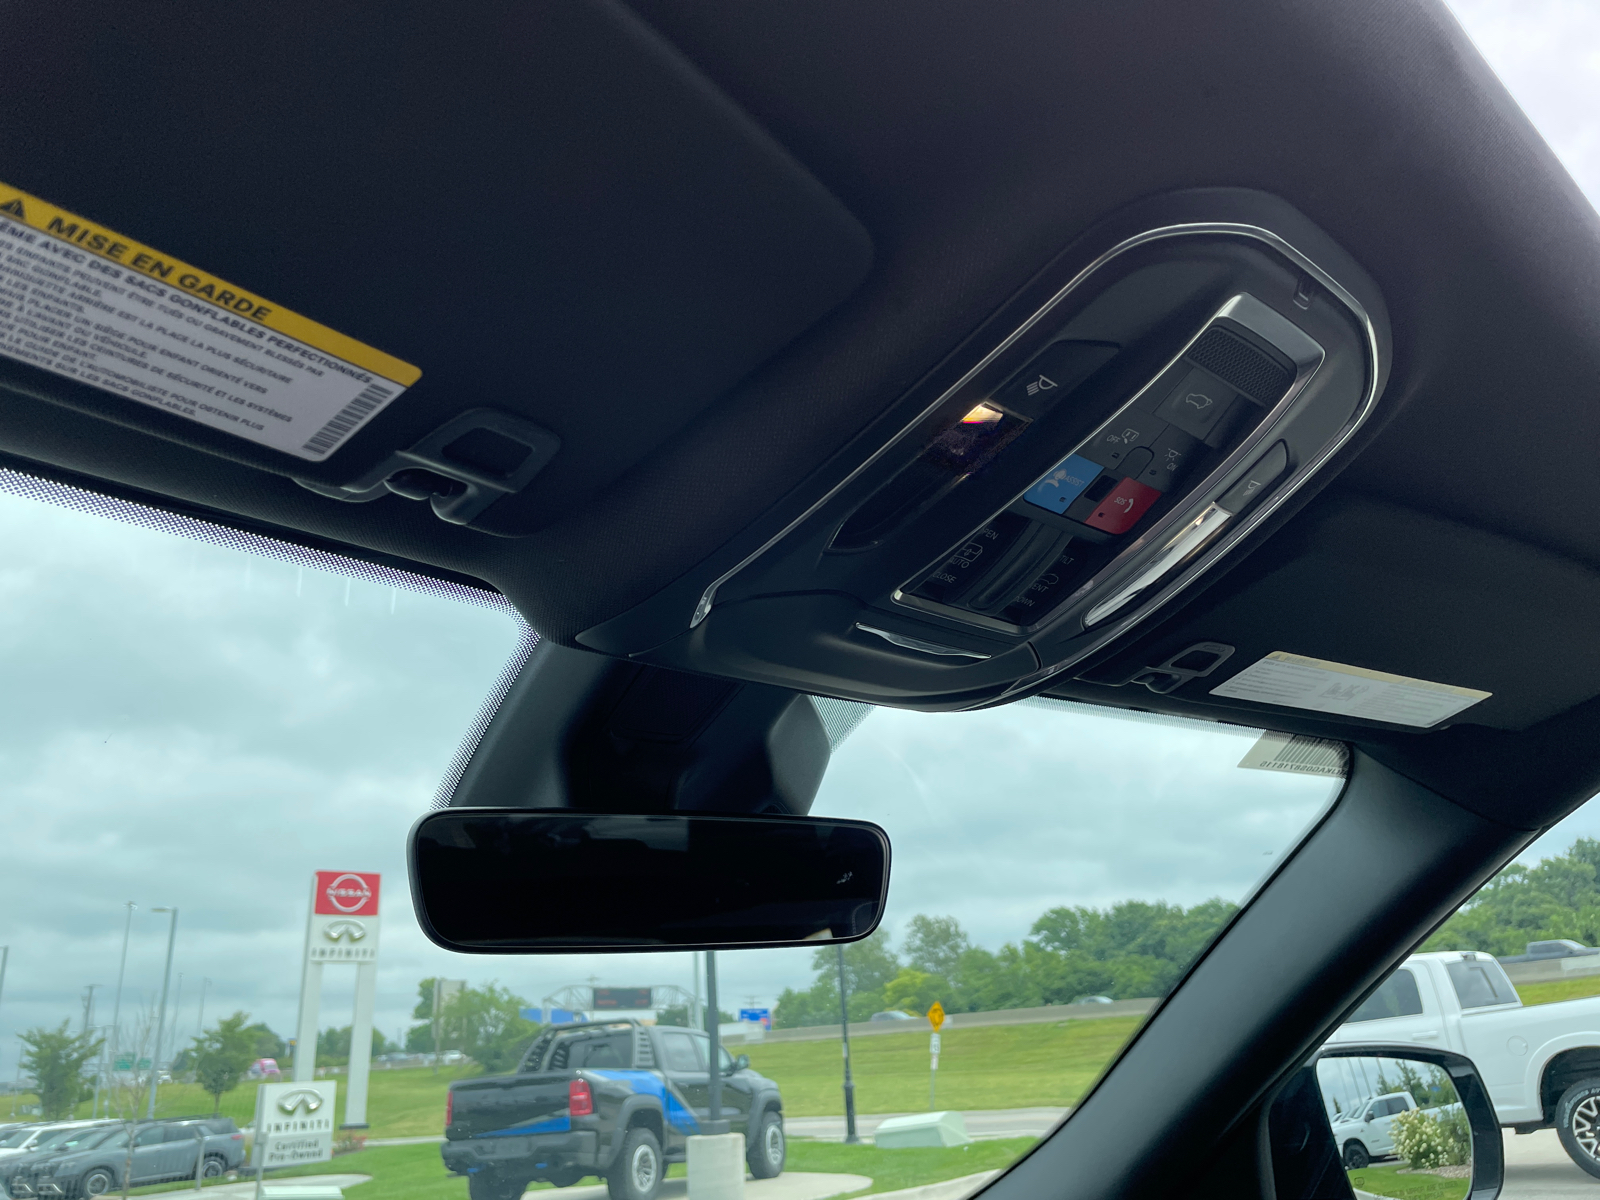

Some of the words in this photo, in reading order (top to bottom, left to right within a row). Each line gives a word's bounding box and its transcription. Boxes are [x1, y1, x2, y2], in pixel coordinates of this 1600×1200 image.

[47, 216, 127, 258] MISE
[130, 252, 173, 278] EN
[176, 272, 272, 320] GARDE
[37, 238, 86, 263] AVEC
[87, 259, 121, 278] DES
[124, 275, 167, 297] SACS
[168, 294, 265, 338] GONFLABLES
[266, 335, 374, 383] PERFECTIONNÉS
[138, 319, 154, 328] LA
[155, 326, 189, 342] PLACE
[189, 339, 204, 348] LA
[205, 345, 232, 359] PLUS
[232, 356, 292, 382] SÉCURITAIRE
[184, 316, 202, 326] OU
[202, 323, 263, 351] GRAVEMENT
[263, 348, 305, 368] BLESSÉS
[305, 365, 325, 376] PAR
[126, 336, 157, 351] POUR
[159, 348, 199, 366] ENFANT
[200, 364, 242, 383] ORIENTÉ
[243, 380, 269, 393] VERS
[150, 365, 165, 374] DE
[165, 371, 214, 392] SÉCURITÉ
[214, 389, 227, 397] ET
[227, 394, 246, 404] LES
[246, 401, 294, 421] SYSTÈMES
[169, 393, 198, 406] POUR
[198, 403, 240, 420] OBTENIR
[240, 418, 265, 429] PLUS
[1106, 434, 1121, 444] OFF
[1166, 462, 1179, 472] ON
[1064, 474, 1085, 487] ASSIST
[1114, 496, 1127, 506] SOS
[949, 556, 970, 569] AUTO
[1060, 554, 1075, 566] TILT
[932, 571, 957, 584] CLOSE
[325, 887, 372, 898] NISSAN
[310, 946, 376, 960] INFINITI
[266, 1119, 330, 1133] INFINITI
[274, 1138, 320, 1151] Certified
[267, 1148, 324, 1162] Pre-Owned
